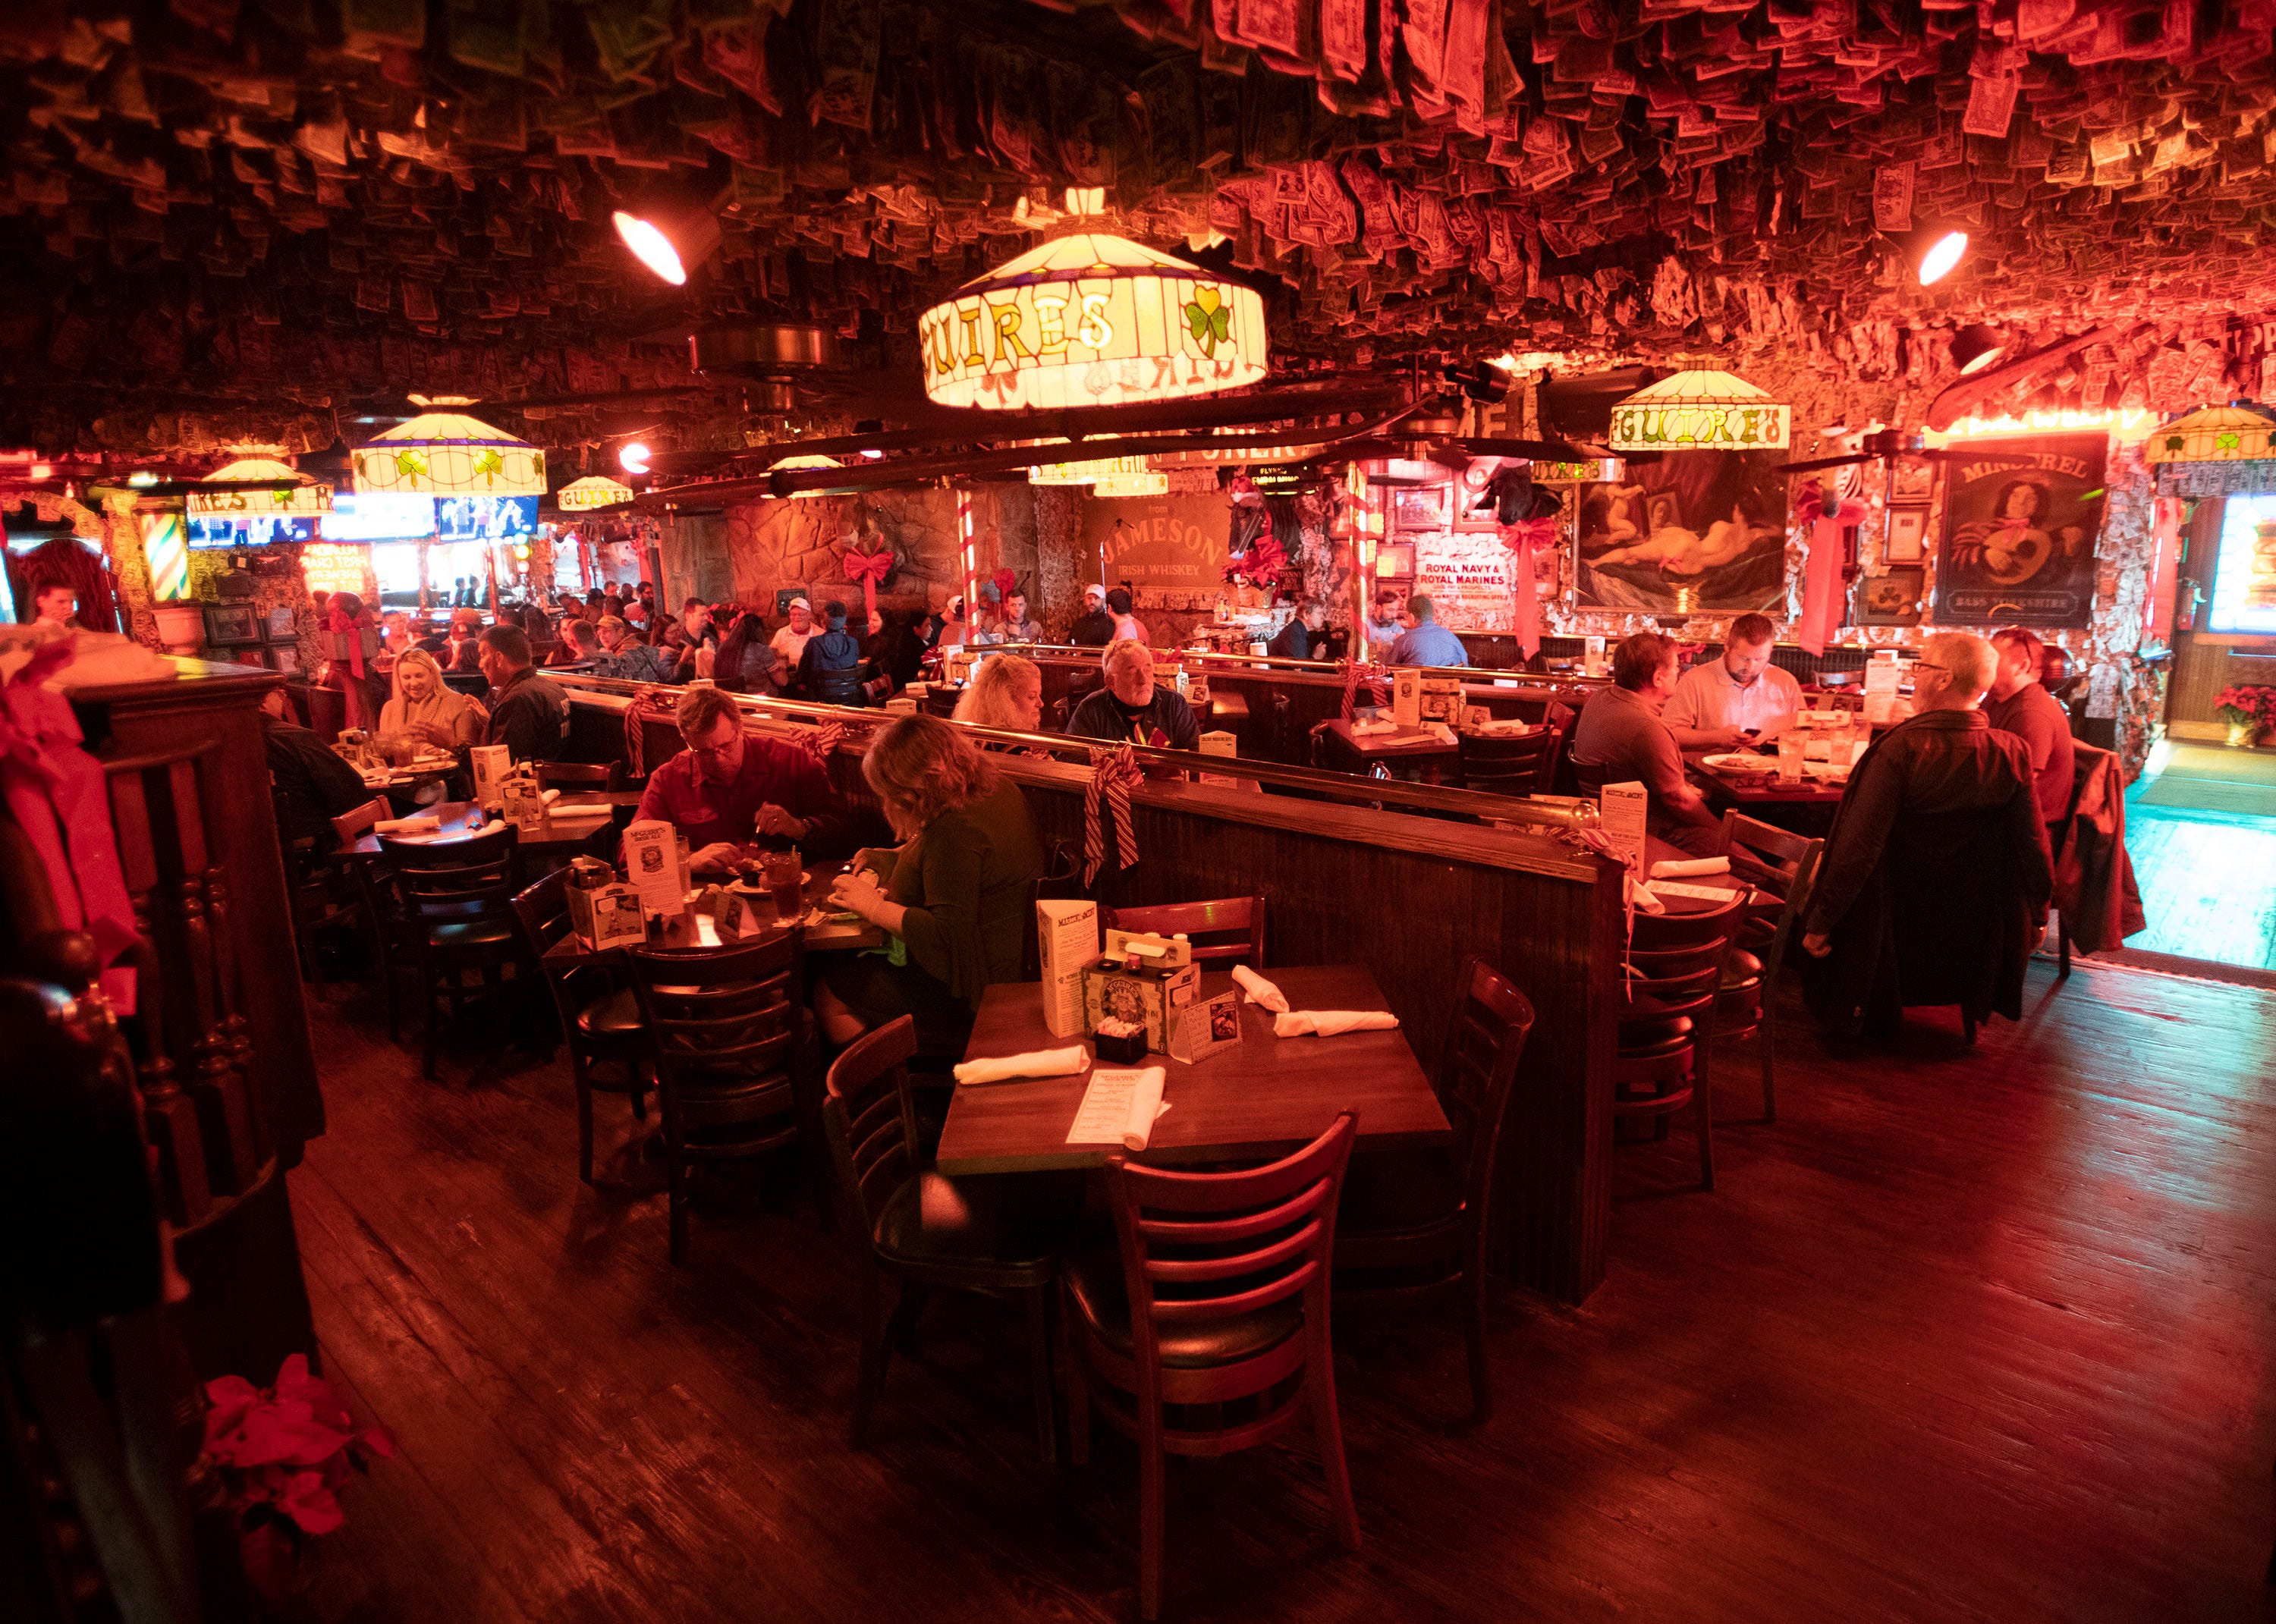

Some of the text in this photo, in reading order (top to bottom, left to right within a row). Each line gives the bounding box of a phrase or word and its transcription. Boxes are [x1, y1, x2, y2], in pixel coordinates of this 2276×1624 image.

[1102, 517, 1223, 566] JAMESON
[1118, 564, 1199, 576] IRISH WHISKEY
[1426, 564, 1458, 573] ROYAL
[1462, 564, 1491, 573] NAVY
[1420, 575, 1504, 585] ROYAL MARINES
